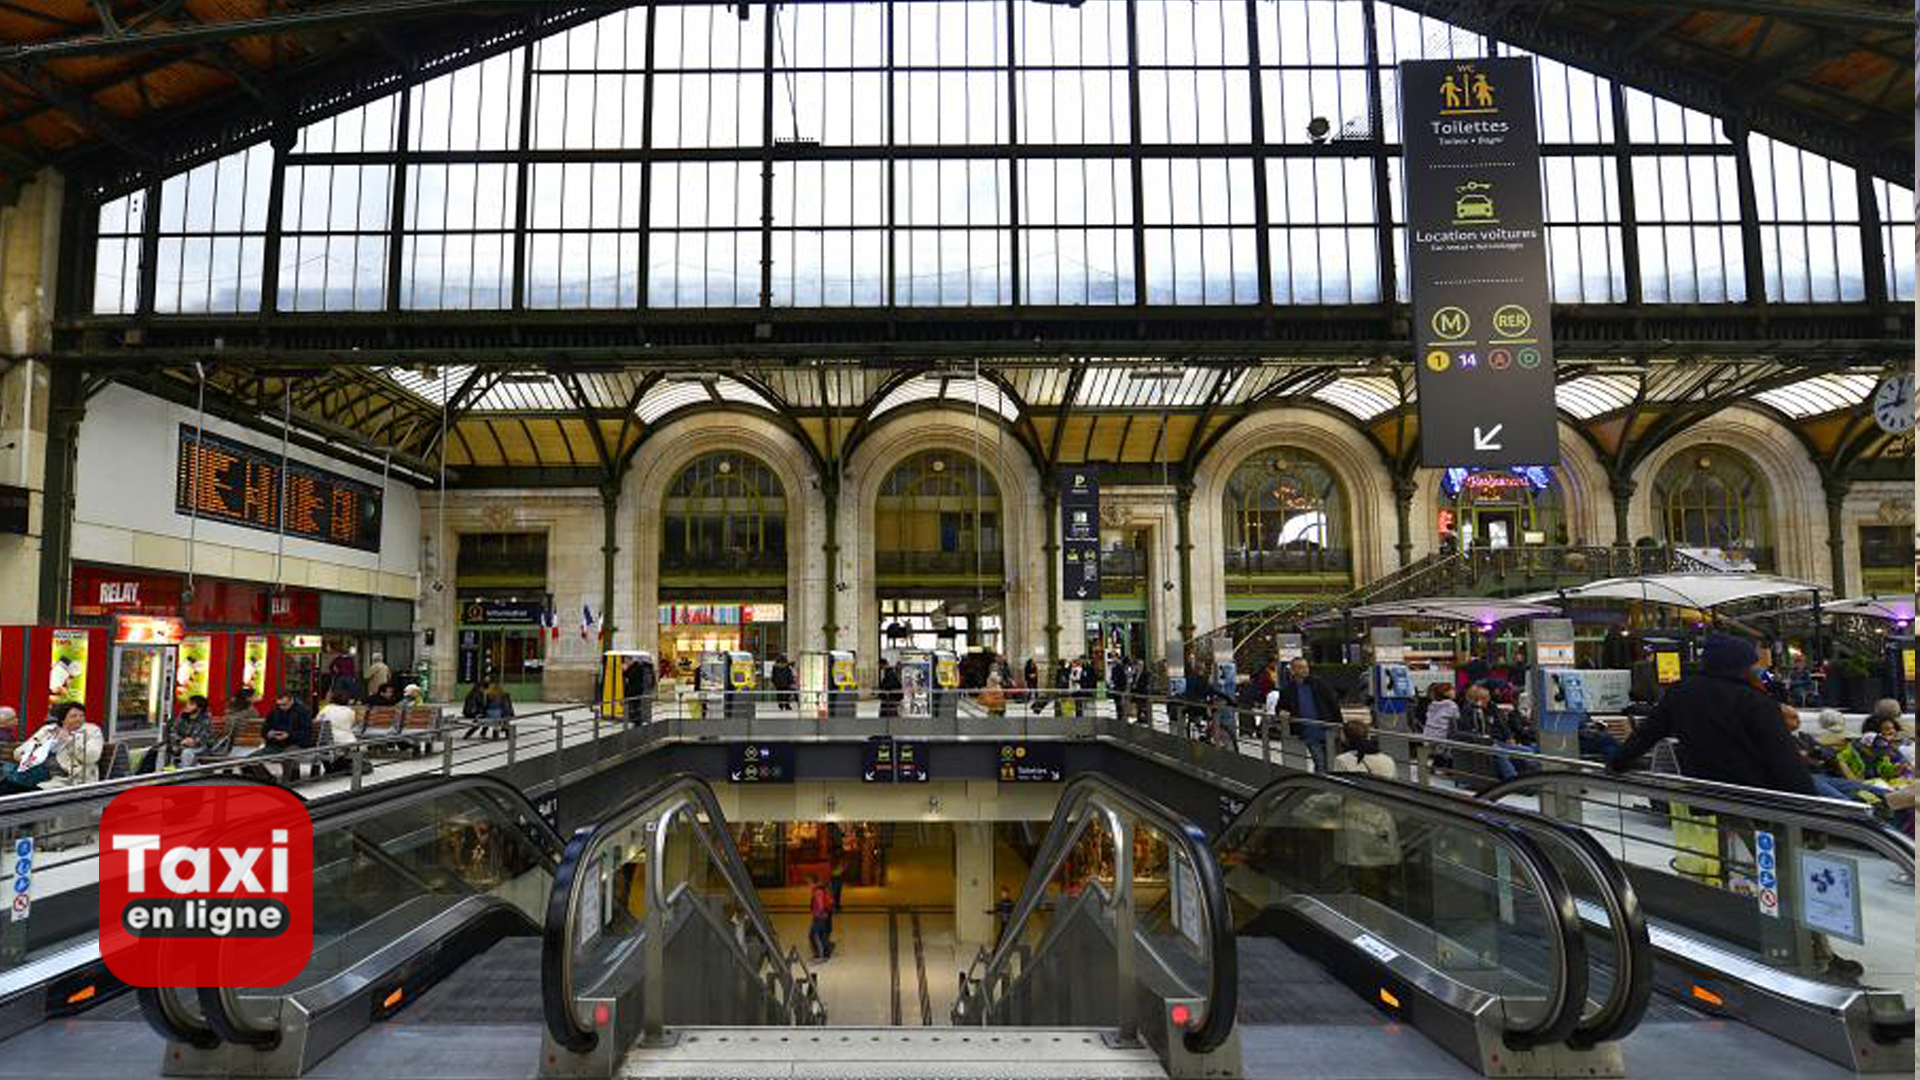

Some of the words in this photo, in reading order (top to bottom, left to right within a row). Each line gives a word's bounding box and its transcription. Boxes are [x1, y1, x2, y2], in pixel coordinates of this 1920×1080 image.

[1457, 65, 1475, 73] WC
[1431, 120, 1510, 134] Toilettes
[1416, 230, 1478, 242] Location
[1480, 228, 1537, 240] voitures
[1440, 314, 1462, 332] M
[1499, 315, 1527, 328] RER
[1458, 353, 1477, 367] 14
[100, 582, 140, 604] RELAY
